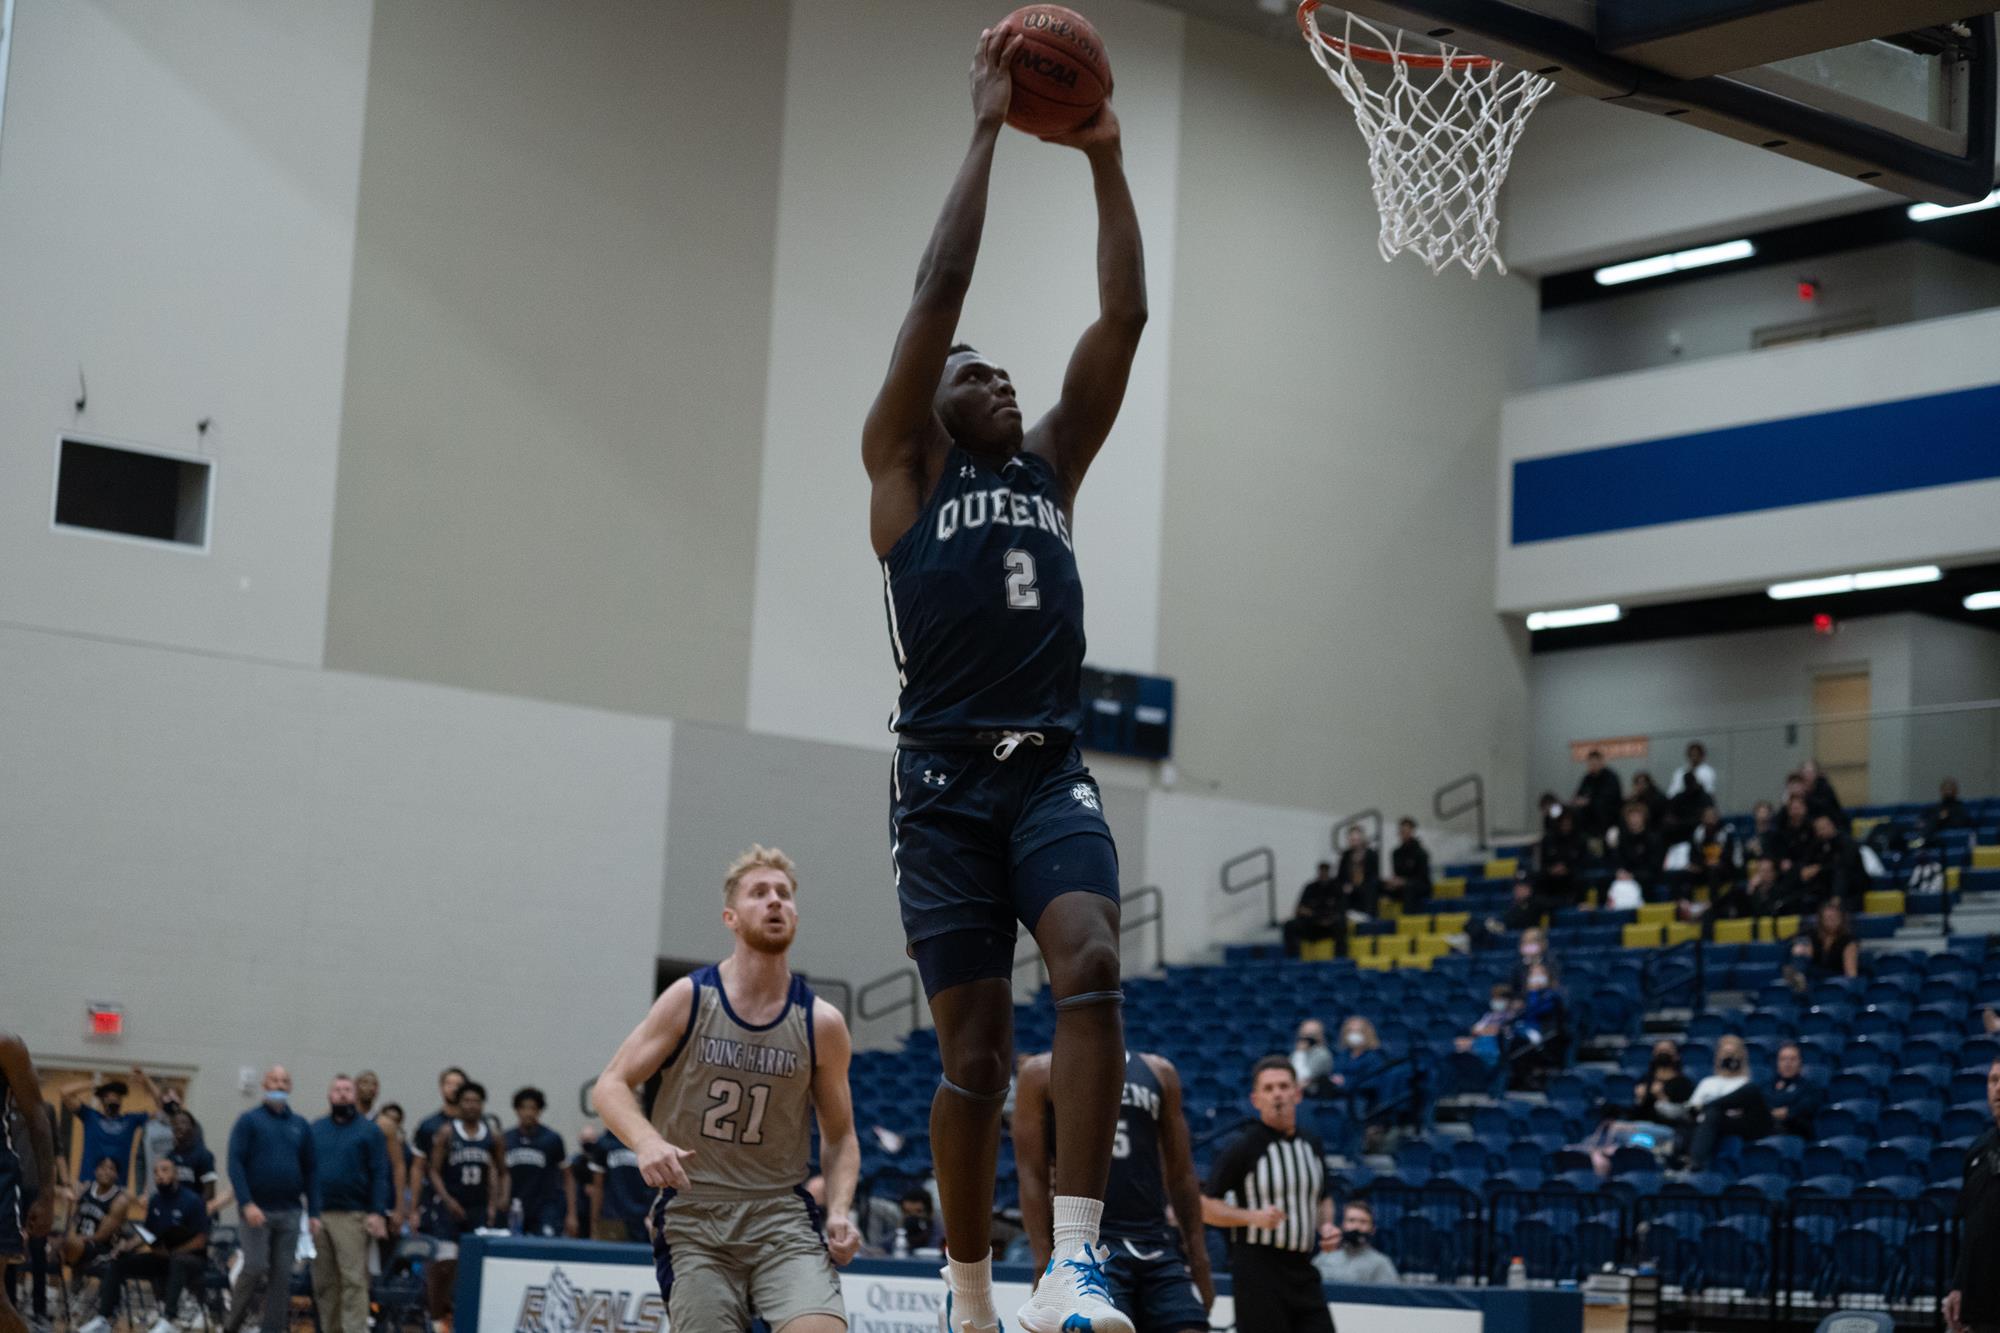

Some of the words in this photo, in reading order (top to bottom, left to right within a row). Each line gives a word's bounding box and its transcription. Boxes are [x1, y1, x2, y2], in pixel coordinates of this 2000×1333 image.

[936, 487, 1073, 551] QUEENS
[1003, 548, 1041, 610] 2
[698, 1036, 744, 1071] YOUNG
[743, 1042, 797, 1079] HARRIS
[701, 1076, 771, 1145] 21
